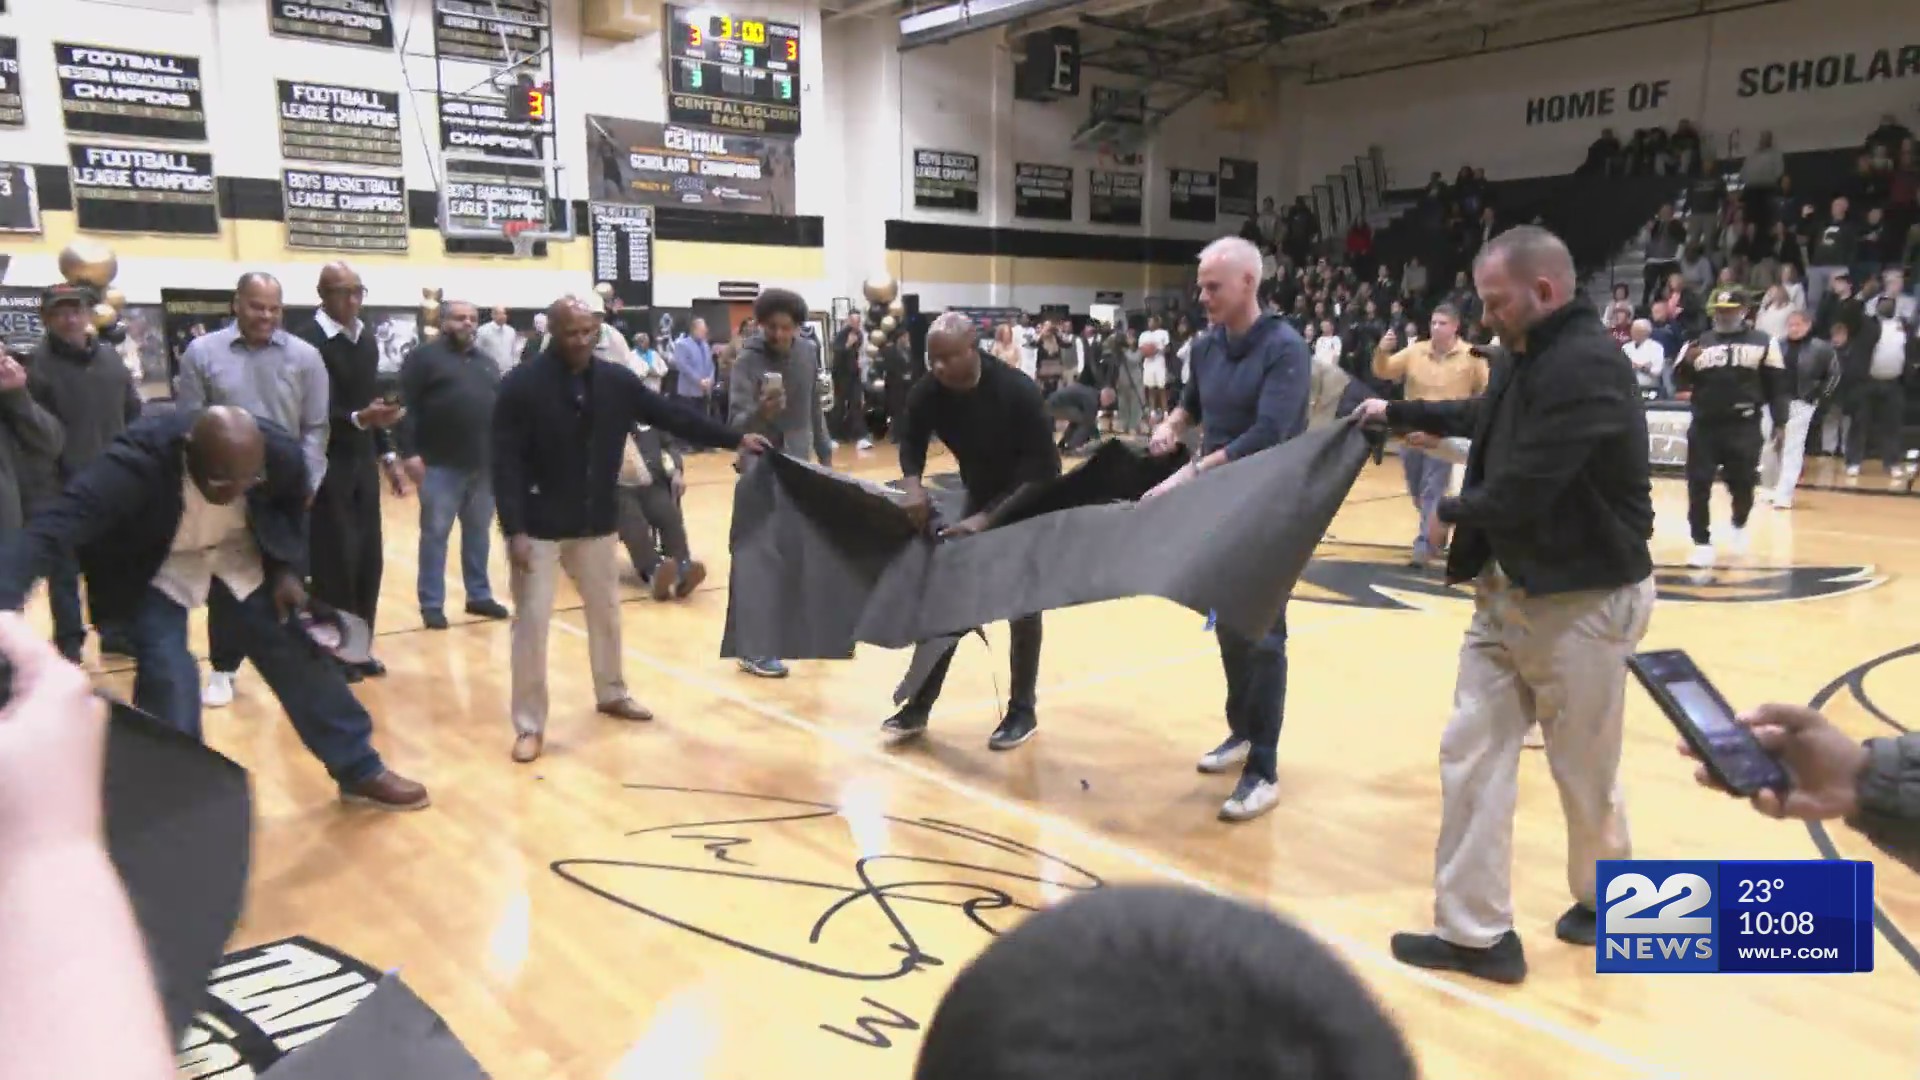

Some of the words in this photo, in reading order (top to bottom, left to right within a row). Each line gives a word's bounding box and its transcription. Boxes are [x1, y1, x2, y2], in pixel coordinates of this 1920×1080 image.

[282, 4, 383, 30] CHAMPIONS
[688, 25, 702, 47] 3
[71, 48, 184, 74] FOOTBALL
[784, 38, 798, 61] 3
[1051, 44, 1073, 92] E
[1737, 44, 1920, 99] SCHOLAR
[73, 83, 190, 107] CHAMPIONS
[287, 85, 386, 110] FOOTBALL
[528, 89, 544, 117] 3
[1526, 88, 1615, 126] HOME
[1627, 80, 1671, 113] OF
[282, 102, 331, 122] LEAGUE
[333, 106, 399, 128] CHAMPIONS
[674, 96, 741, 115] CENTRAL
[742, 104, 799, 121] GOLDEN
[711, 113, 766, 131] EAGLES
[664, 127, 728, 155] CENTRAL
[87, 148, 196, 173] FOOTBALL
[73, 167, 132, 187] LEAGUE
[134, 171, 213, 192] CHAMPIONS
[288, 171, 321, 190] BOYS
[324, 175, 401, 195] BASKETBALL
[288, 190, 337, 209] LEAGUE
